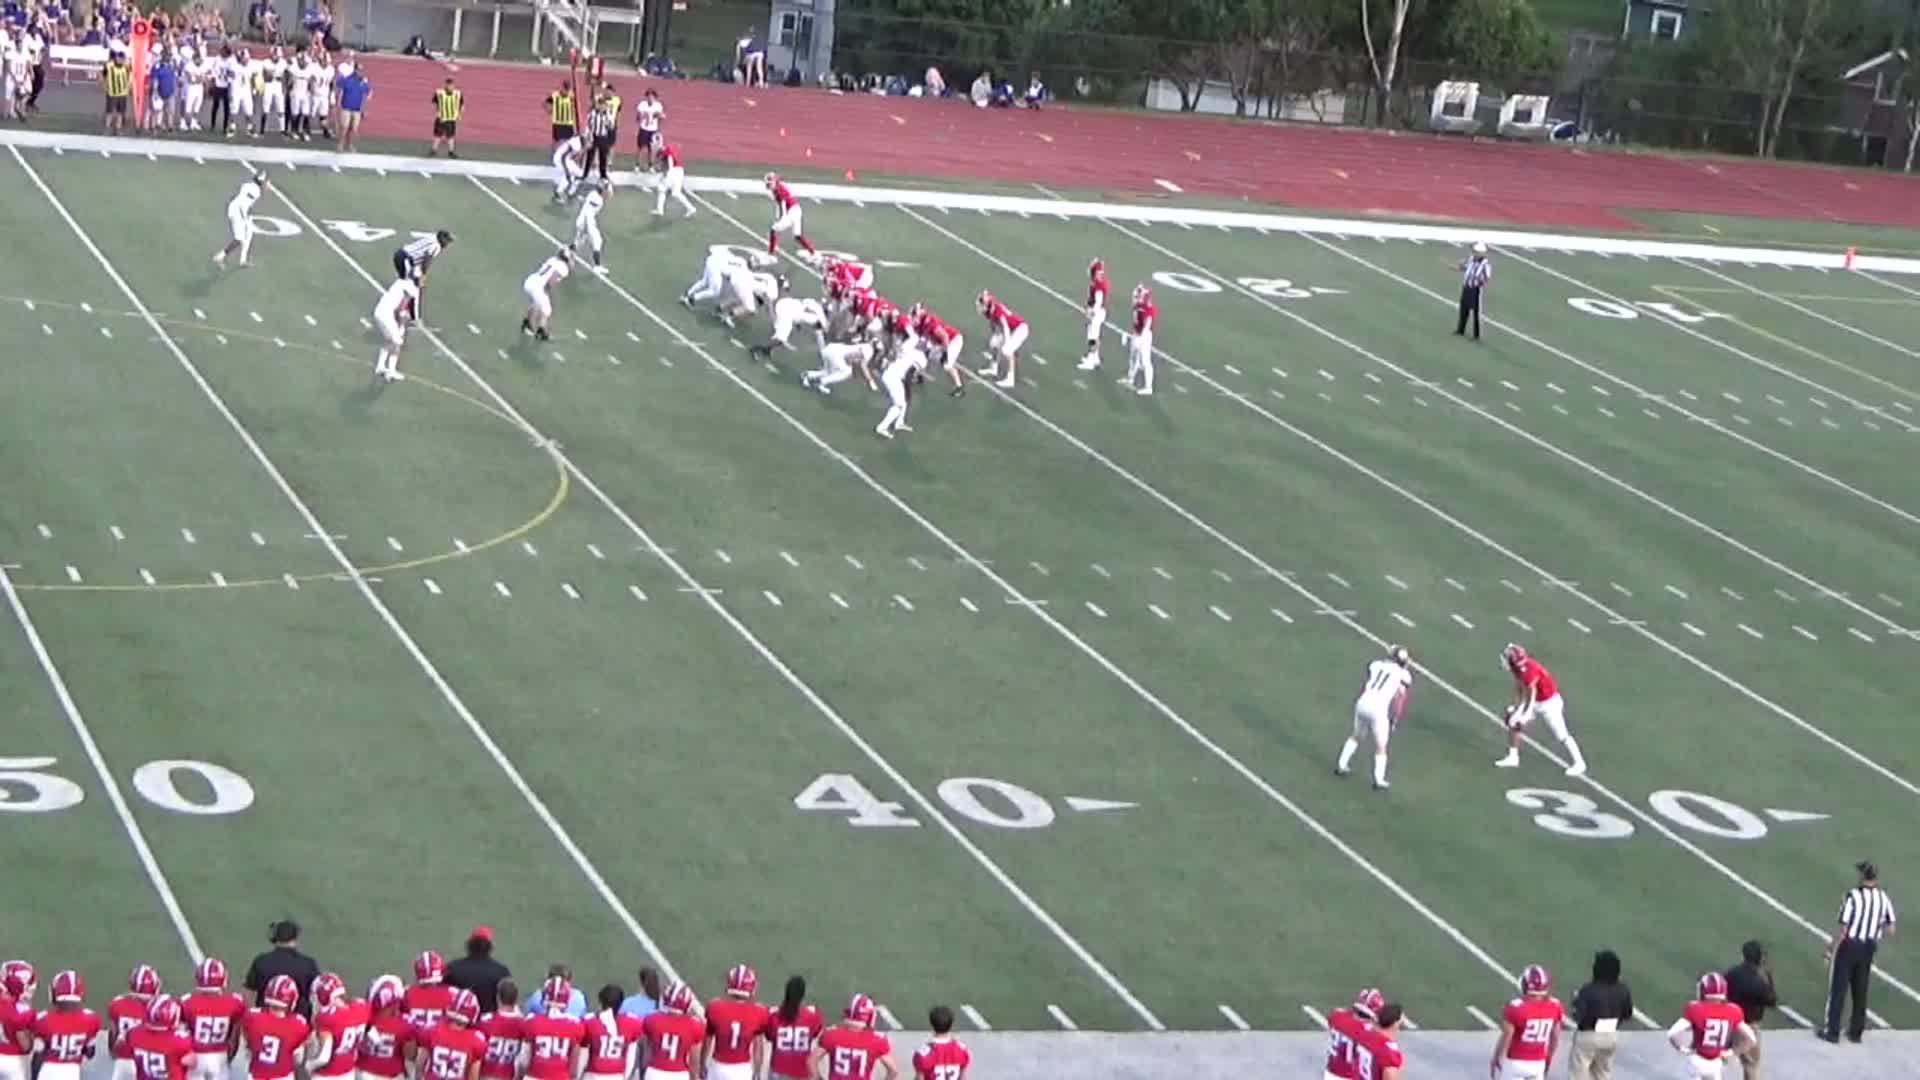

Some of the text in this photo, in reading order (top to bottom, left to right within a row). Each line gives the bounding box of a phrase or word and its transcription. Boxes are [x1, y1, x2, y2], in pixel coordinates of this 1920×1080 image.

[1152, 271, 1313, 298] 20
[1370, 669, 1391, 691] 11
[0, 756, 255, 814] 50
[793, 773, 1056, 828] 40
[1505, 788, 1768, 840] 30
[194, 1015, 231, 1044] 69
[730, 1021, 741, 1049] 1
[777, 1026, 810, 1051] 26
[1521, 1018, 1554, 1043] 20
[1702, 1018, 1729, 1048] 21
[50, 1033, 88, 1060] 45
[259, 1035, 281, 1063] 3
[535, 1035, 570, 1059] 34
[599, 1034, 624, 1058] 16
[661, 1033, 680, 1061] 4
[431, 1045, 469, 1079] 53
[834, 1046, 868, 1078] 57
